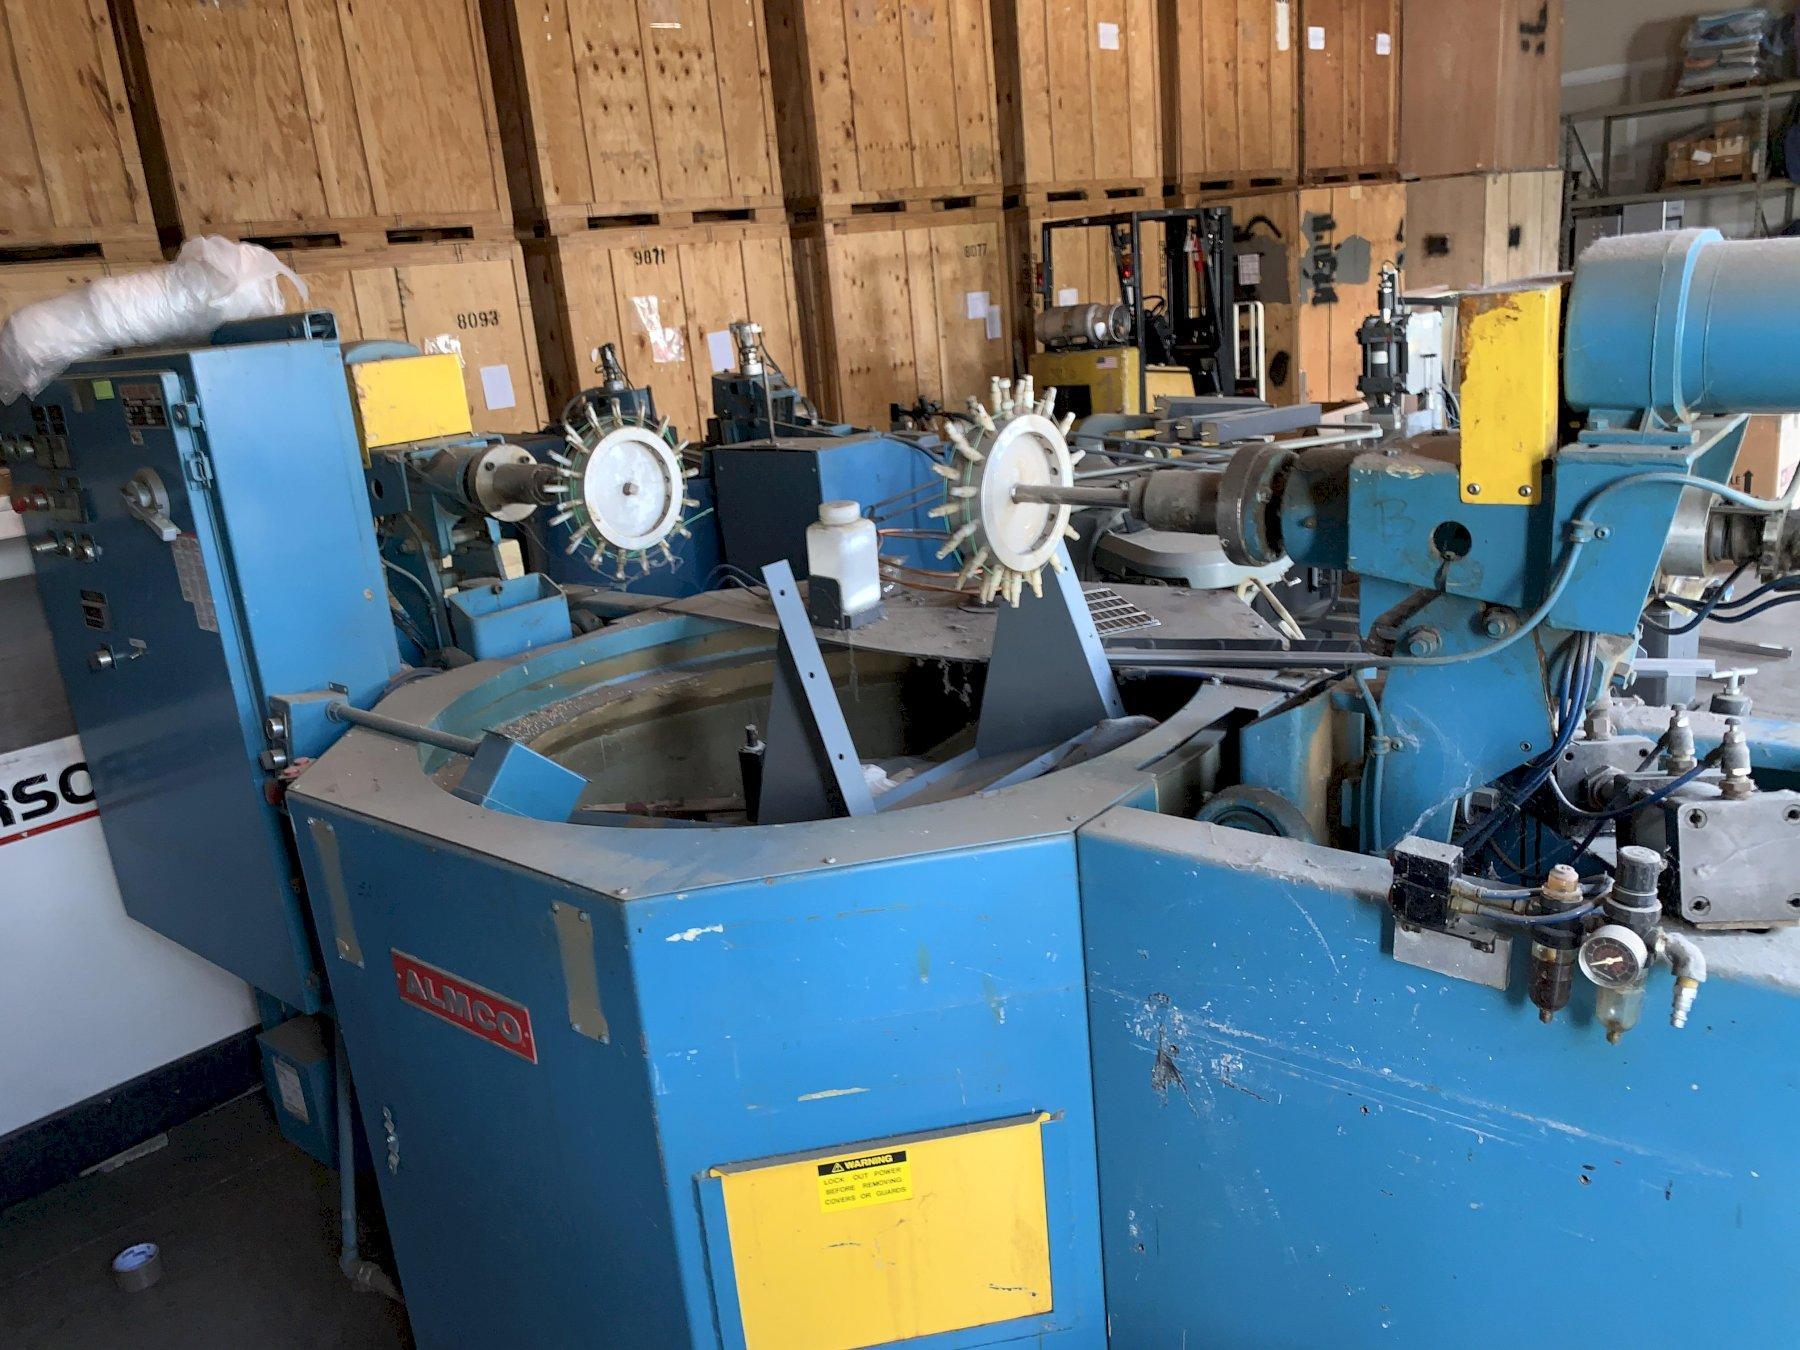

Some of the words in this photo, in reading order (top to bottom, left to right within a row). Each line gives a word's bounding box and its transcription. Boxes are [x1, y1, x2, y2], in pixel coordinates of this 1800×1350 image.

[457, 309, 499, 330] 8093
[406, 969, 522, 1044] ALMCO
[843, 1154, 894, 1170] WARNING
[823, 1177, 845, 1186] LOCK
[852, 1172, 868, 1181] OUT
[873, 1167, 902, 1177] POWER
[825, 1185, 855, 1195] BEFORE
[862, 1176, 902, 1189] REMOVING
[824, 1195, 856, 1205] COVERS
[860, 1192, 872, 1200] OR
[875, 1186, 907, 1197] GUARDS
